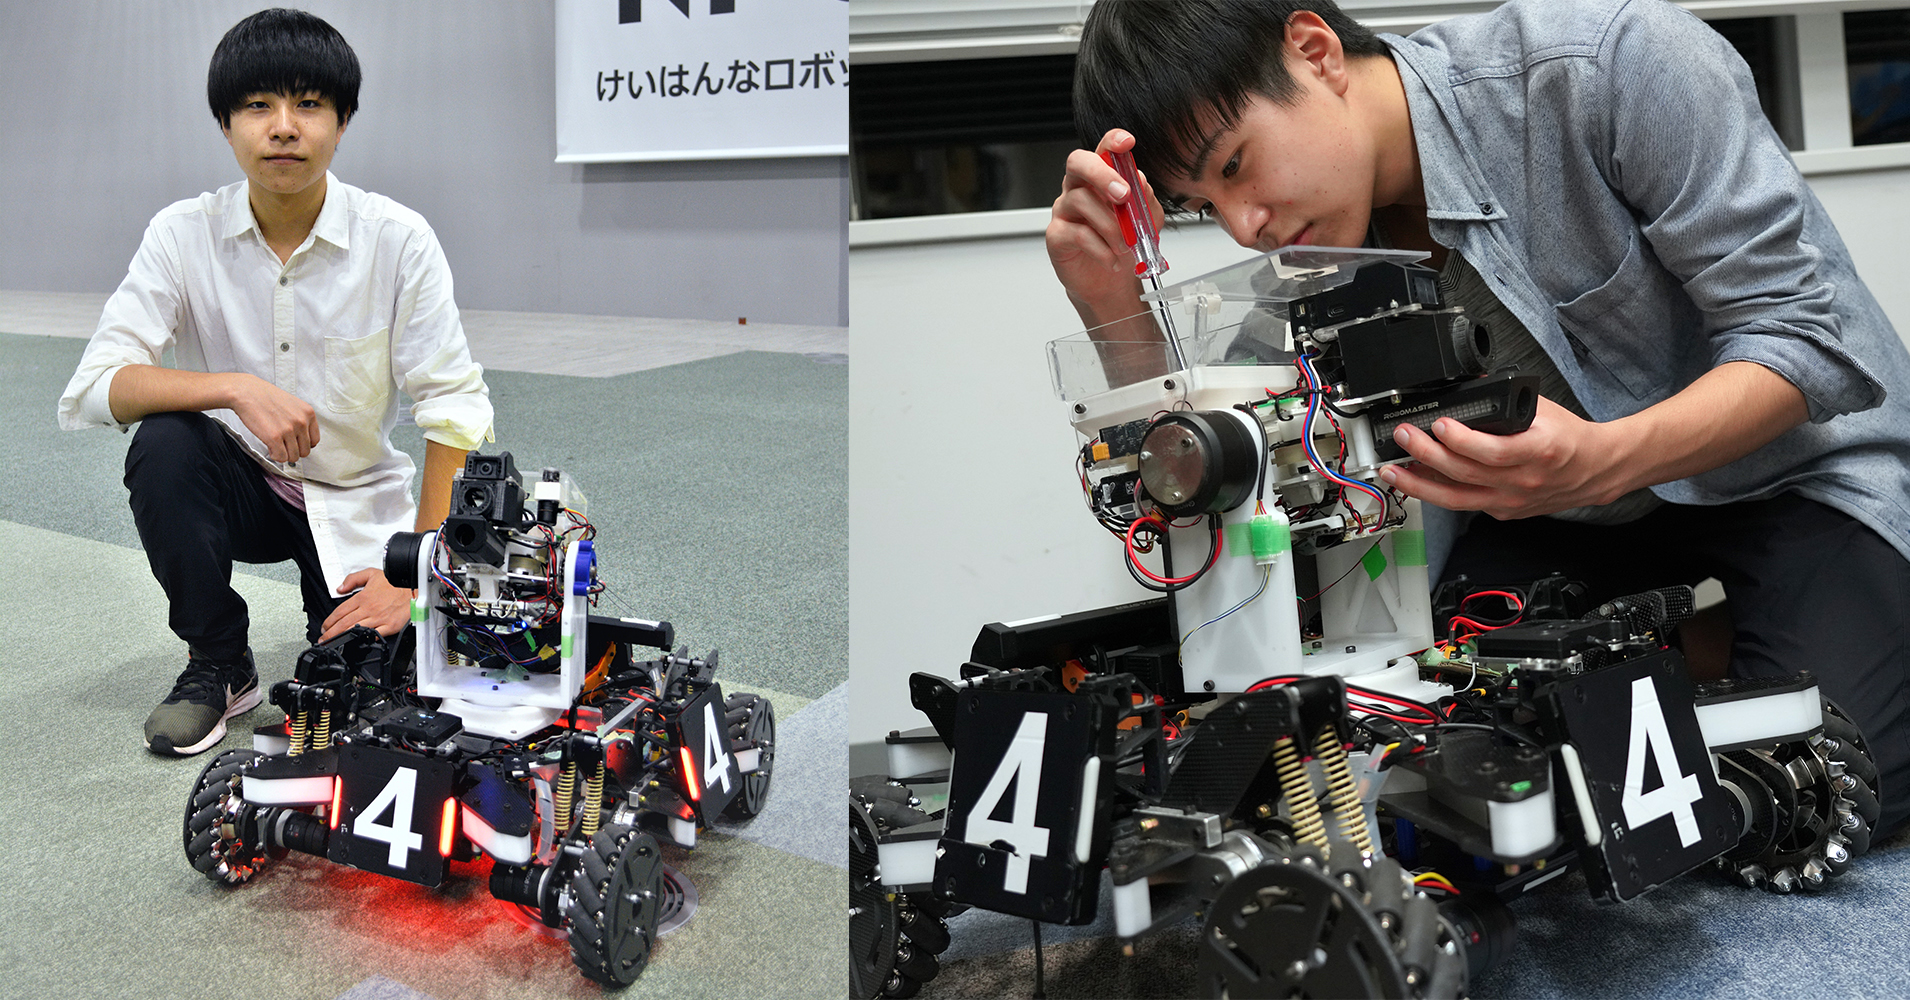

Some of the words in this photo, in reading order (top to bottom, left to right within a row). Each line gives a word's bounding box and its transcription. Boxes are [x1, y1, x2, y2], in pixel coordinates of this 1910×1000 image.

[1383, 401, 1439, 420] ROBOMASTER
[703, 701, 733, 795] 4
[1622, 675, 1703, 848] 4
[353, 766, 423, 869] 4
[965, 711, 1050, 894] 4
